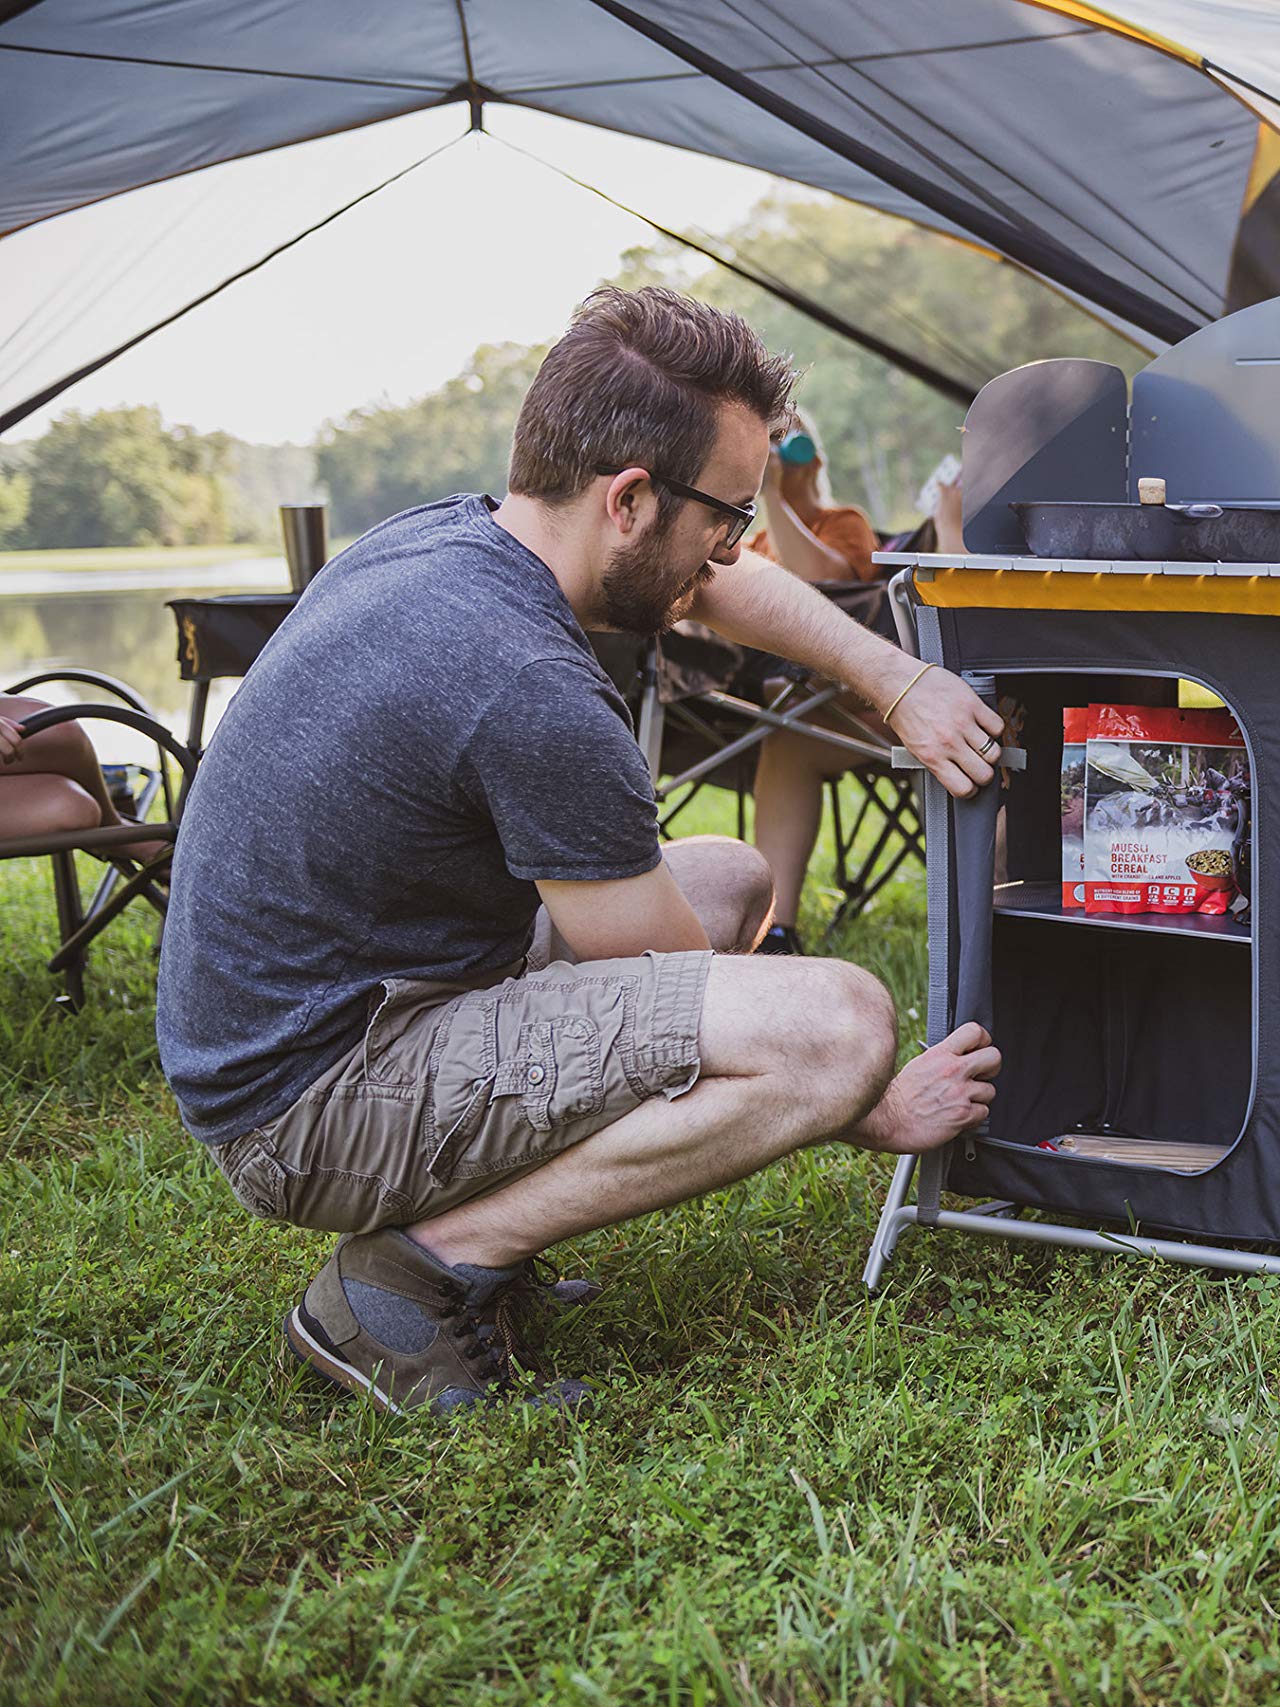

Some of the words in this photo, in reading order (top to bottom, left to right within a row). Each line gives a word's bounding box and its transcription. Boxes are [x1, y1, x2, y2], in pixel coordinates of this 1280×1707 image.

[1111, 843, 1149, 853] MUESLI
[1111, 853, 1168, 864] BREAKFAST
[1111, 864, 1148, 873] CEREAL
